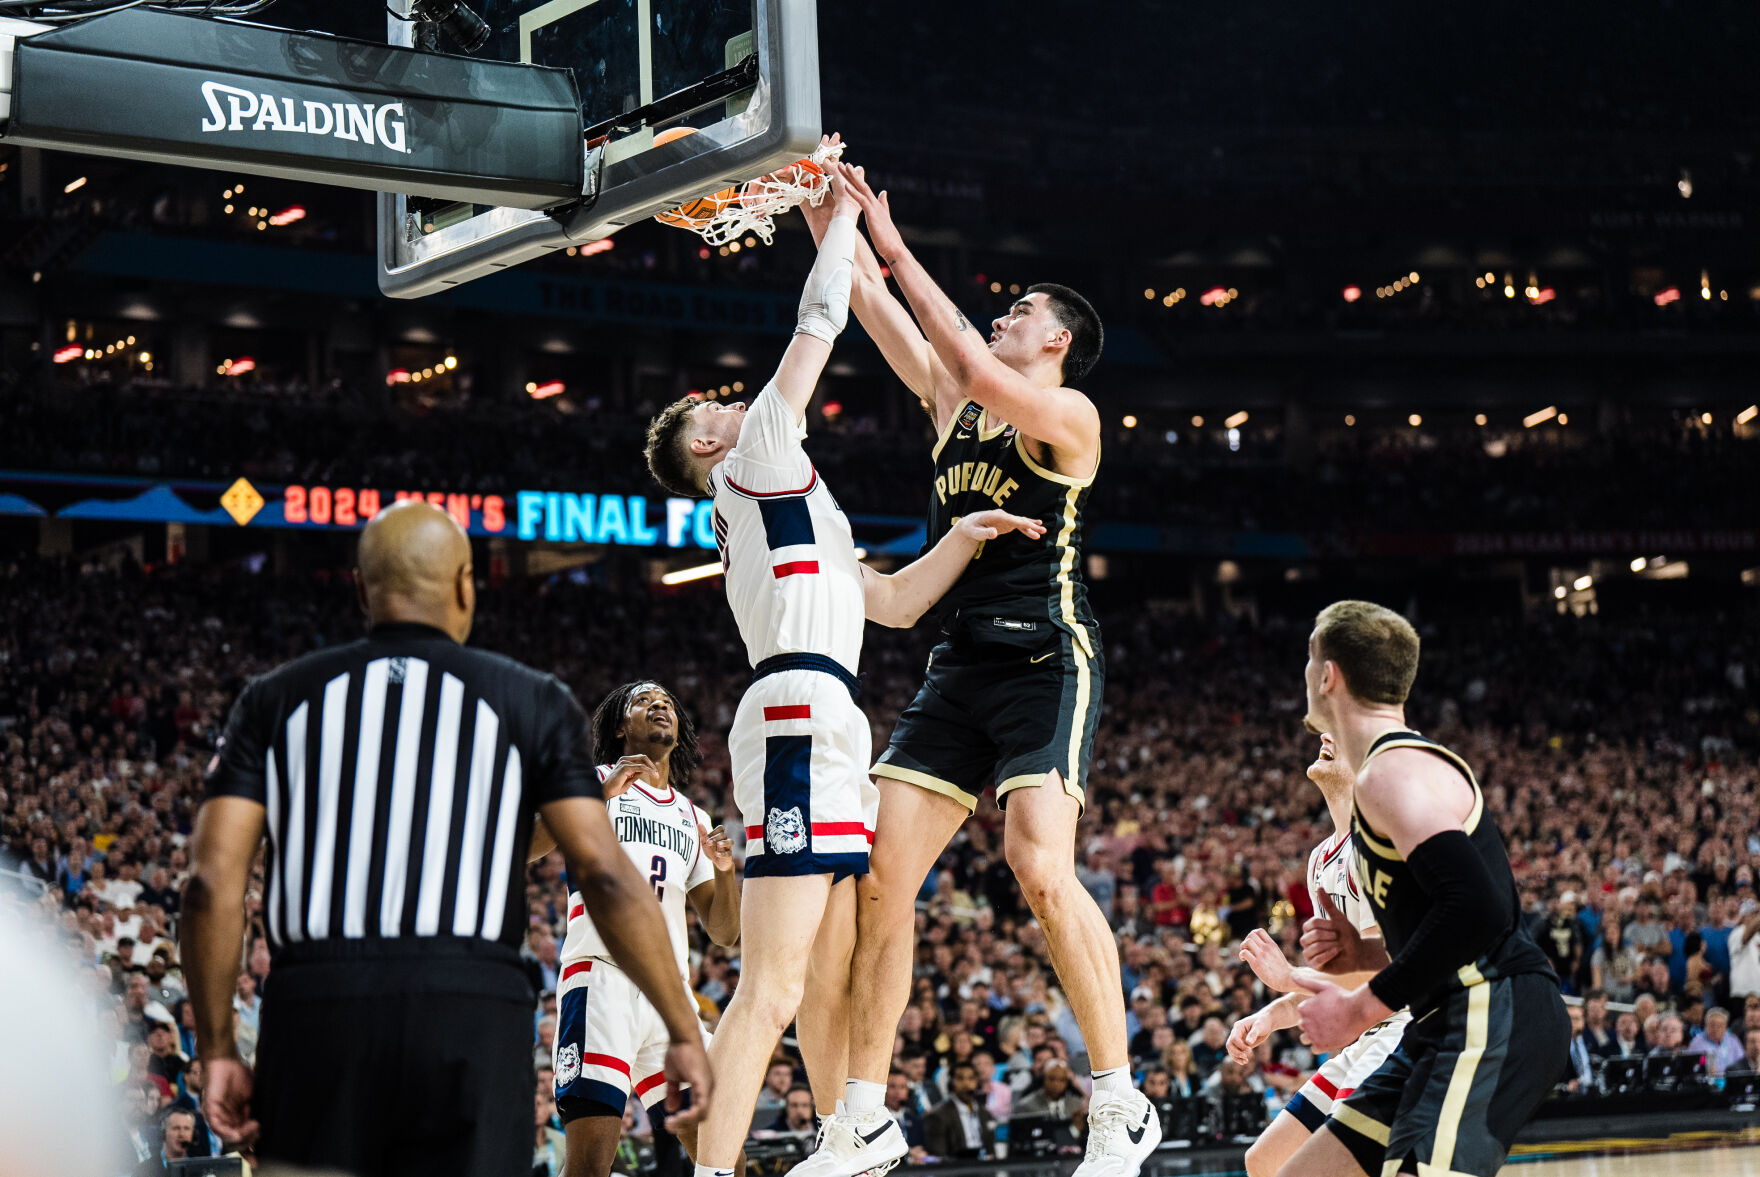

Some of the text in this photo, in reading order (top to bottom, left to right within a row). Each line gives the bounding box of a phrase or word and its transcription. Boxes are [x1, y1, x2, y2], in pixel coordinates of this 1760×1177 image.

[201, 80, 407, 154] SPALDING
[538, 280, 597, 313] THE
[604, 286, 684, 320] ROAD
[284, 485, 380, 525] 2024
[516, 489, 659, 547] FINAL
[650, 855, 667, 902] 2
